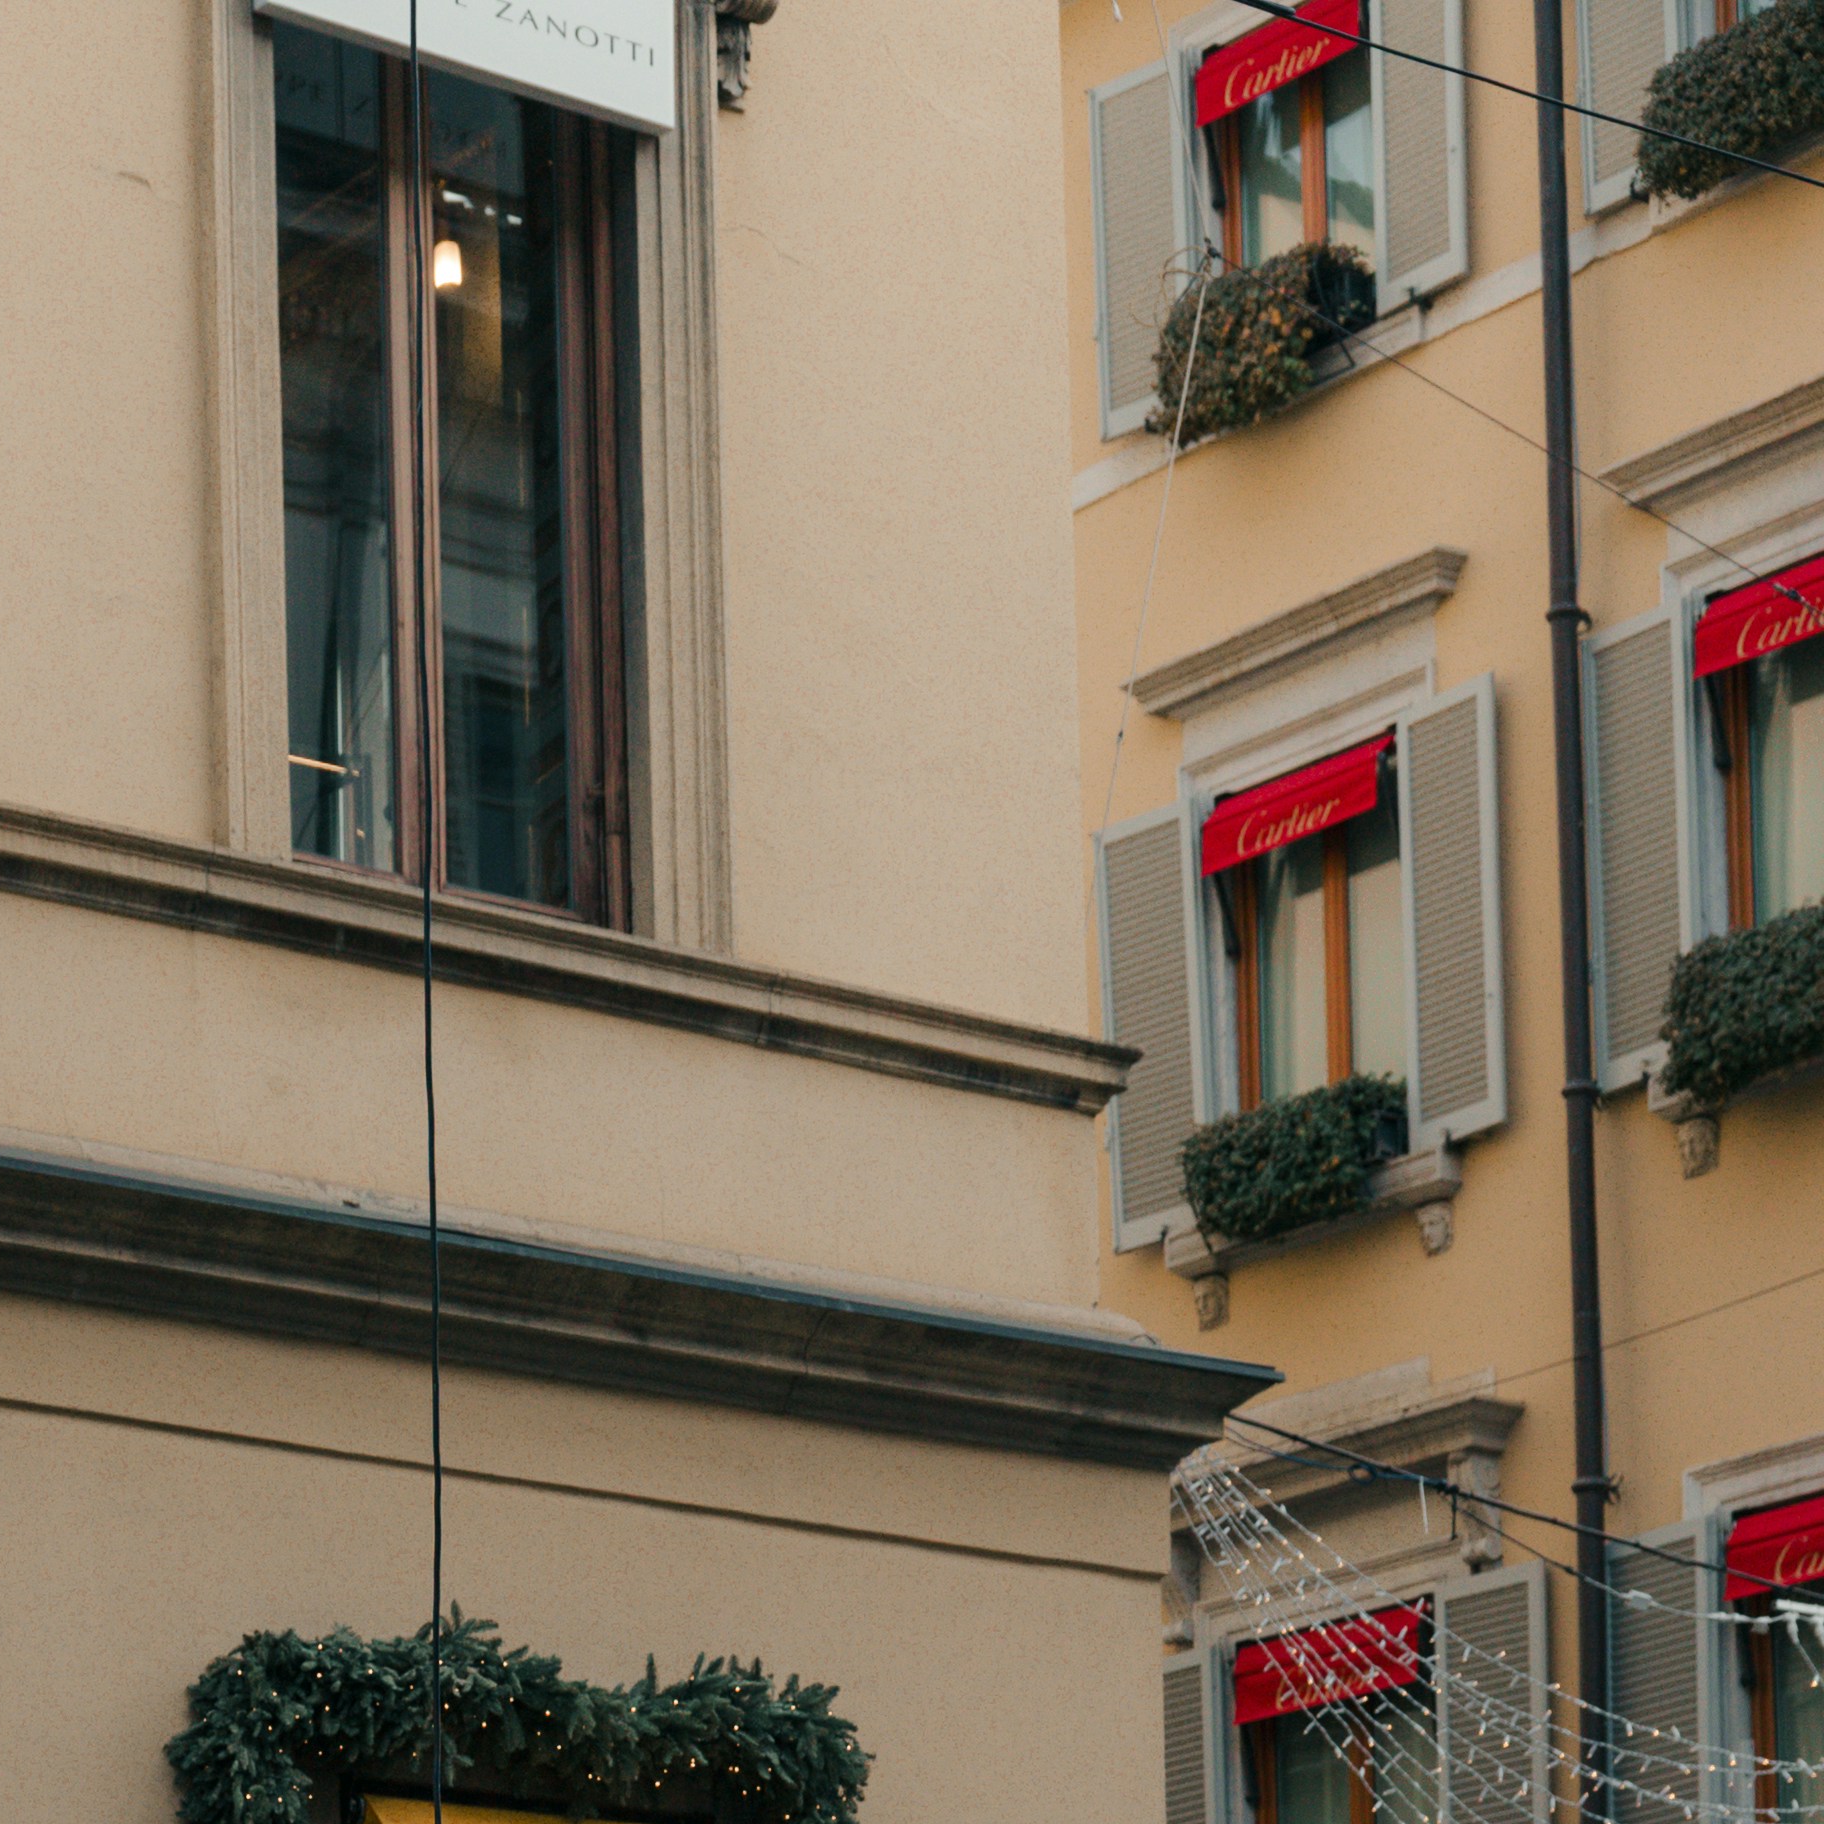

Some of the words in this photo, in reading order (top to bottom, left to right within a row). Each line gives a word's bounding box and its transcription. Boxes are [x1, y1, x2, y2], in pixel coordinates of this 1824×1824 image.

[494, 0, 655, 67] ZANOTTI
[1223, 37, 1331, 109] Cartier
[1236, 797, 1342, 858] Cartier
